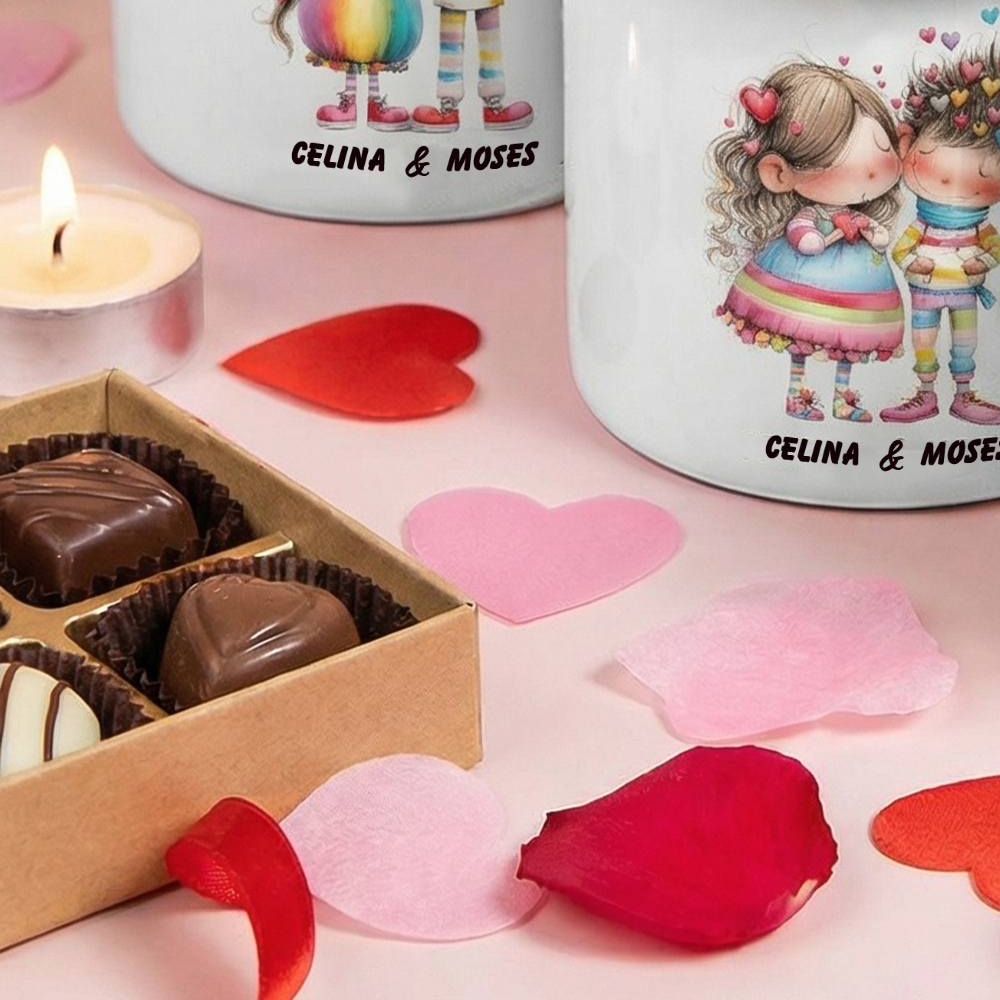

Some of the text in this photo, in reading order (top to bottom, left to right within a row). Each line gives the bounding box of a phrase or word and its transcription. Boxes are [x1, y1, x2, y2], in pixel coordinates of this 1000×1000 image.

[291, 140, 539, 178] CELINA & MOSES
[765, 434, 859, 466] CELINA
[879, 439, 904, 472] &
